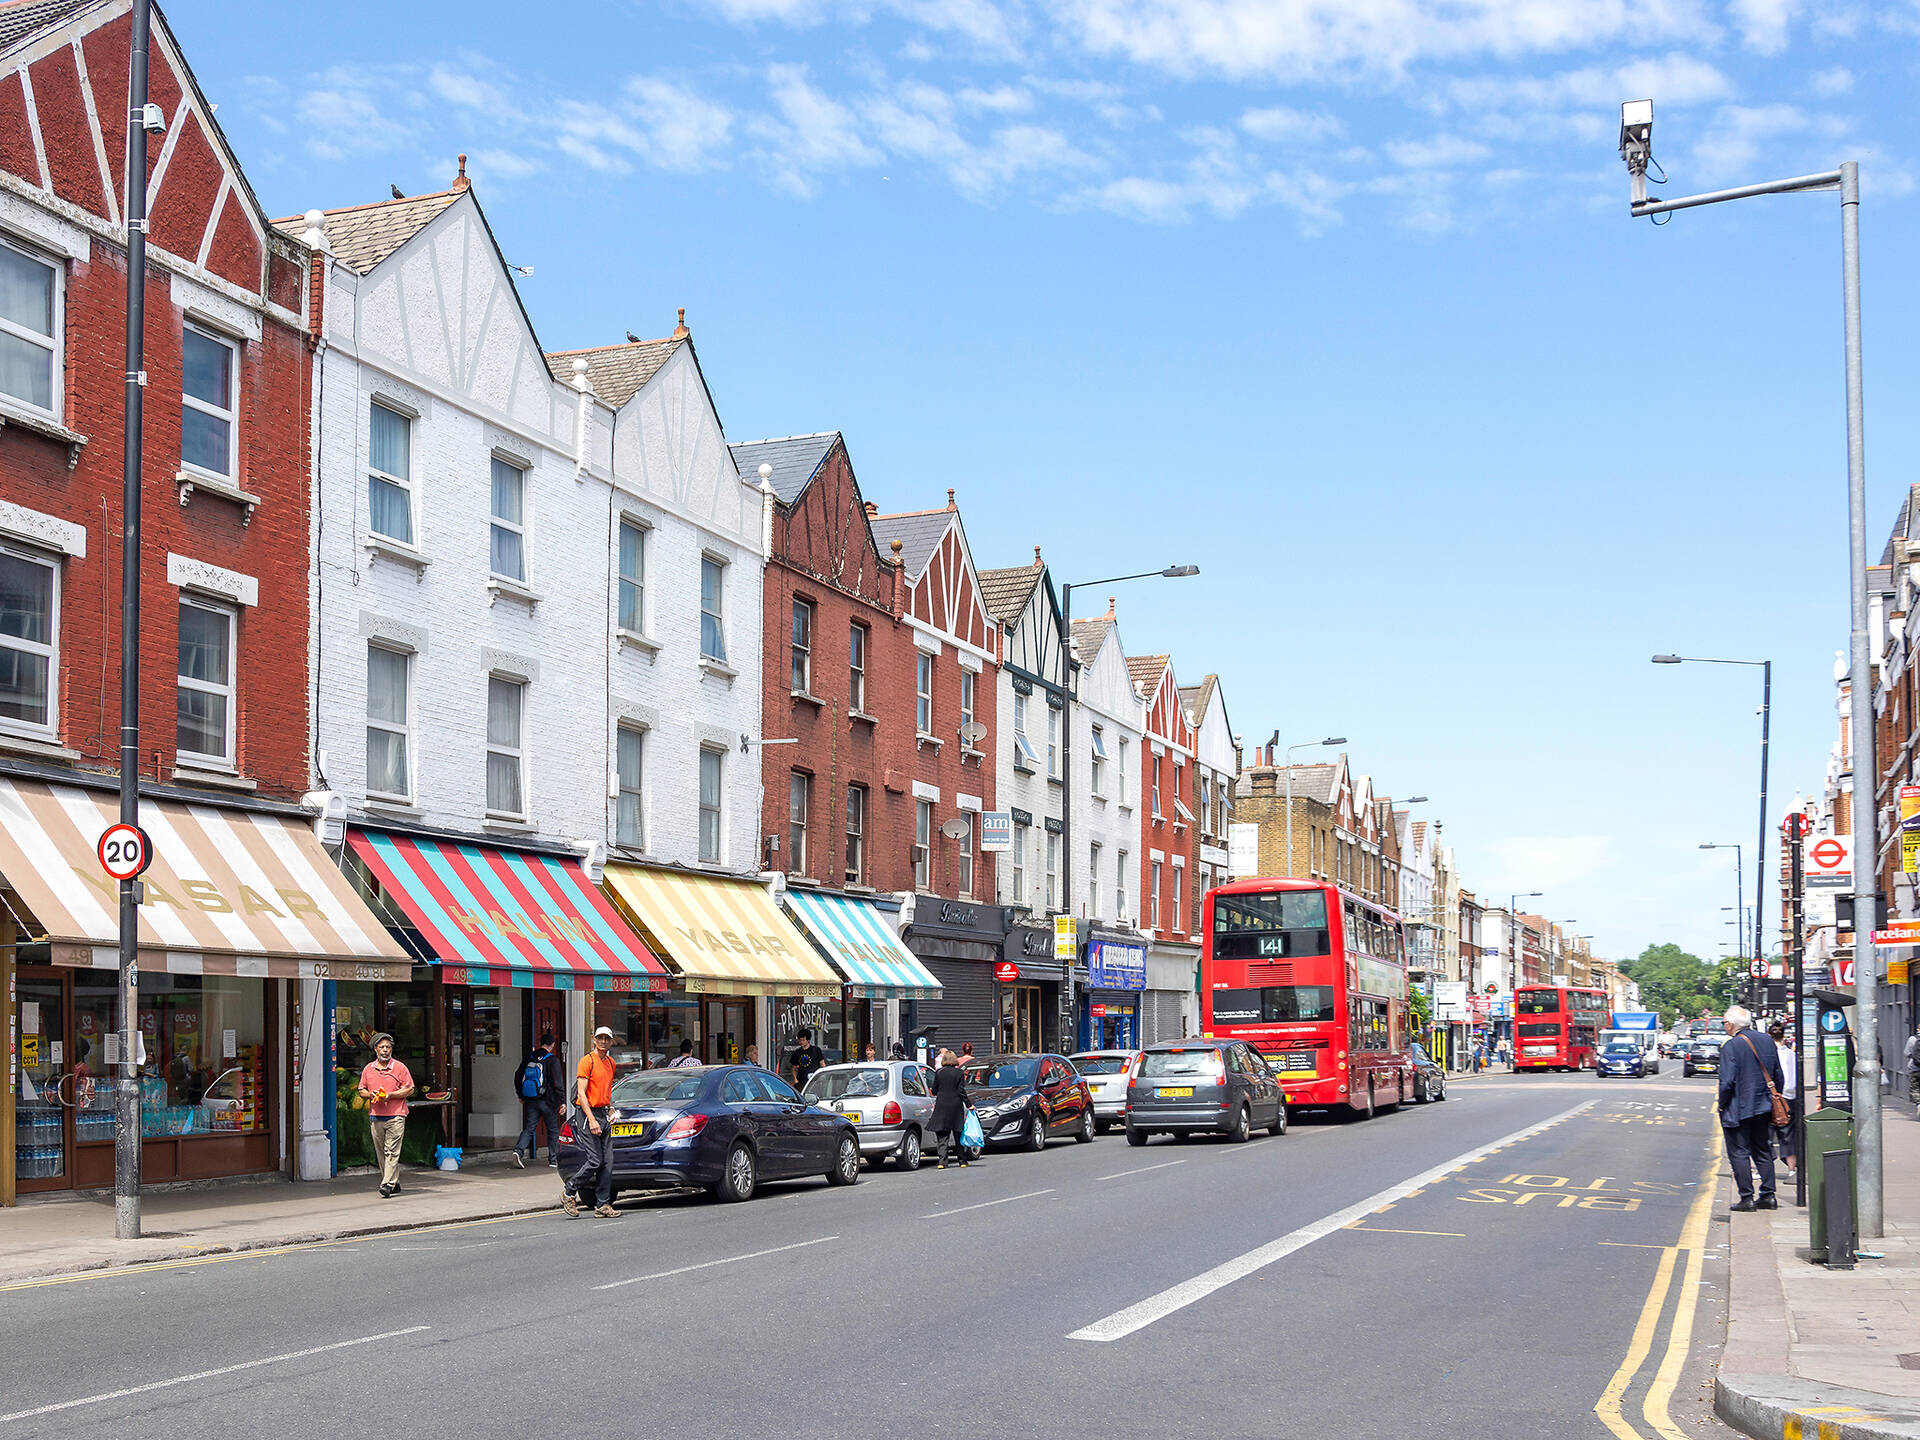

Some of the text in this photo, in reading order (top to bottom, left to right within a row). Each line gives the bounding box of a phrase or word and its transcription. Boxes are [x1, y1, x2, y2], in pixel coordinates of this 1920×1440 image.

[983, 817, 1008, 829] am
[106, 840, 139, 863] 20
[69, 865, 329, 922] YASAR
[448, 905, 598, 944] HALIM
[676, 926, 794, 958] YASAR
[831, 939, 911, 966] HALIM
[1260, 938, 1282, 955] 141
[452, 968, 473, 983] 493
[781, 1003, 831, 1035] PÂTISSERIE
[1533, 1005, 1544, 1013] 29
[23, 1055, 37, 1065] CCTV
[621, 1124, 639, 1135] TVZ
[1456, 1187, 1643, 1212] BUS
